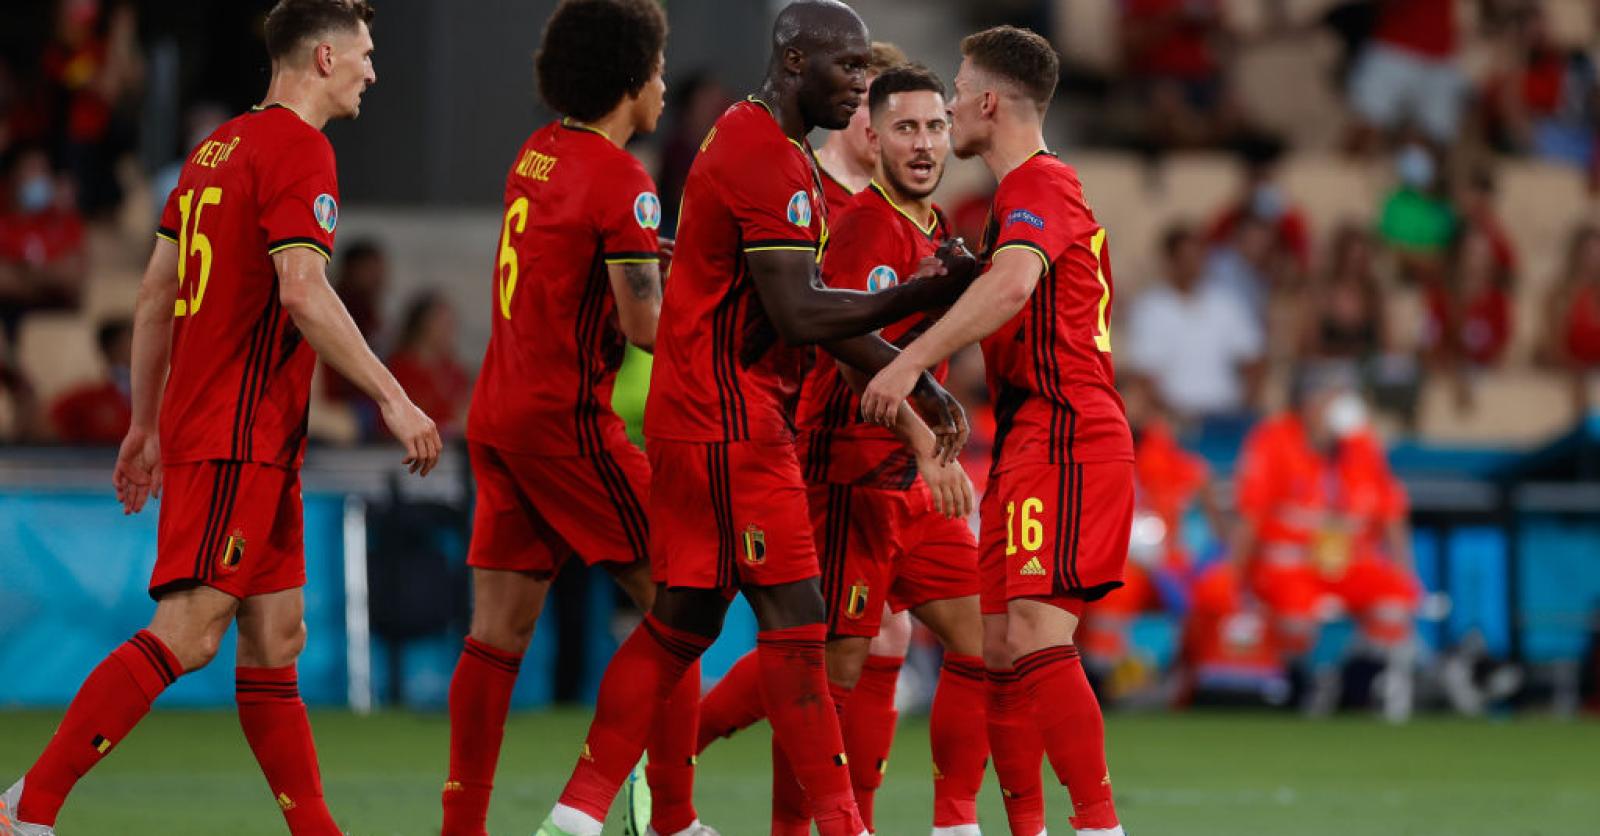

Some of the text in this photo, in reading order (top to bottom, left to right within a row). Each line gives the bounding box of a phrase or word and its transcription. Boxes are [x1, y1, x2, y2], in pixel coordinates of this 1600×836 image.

[175, 187, 222, 316] 15
[499, 197, 529, 320] 6
[1006, 497, 1043, 555] 16
